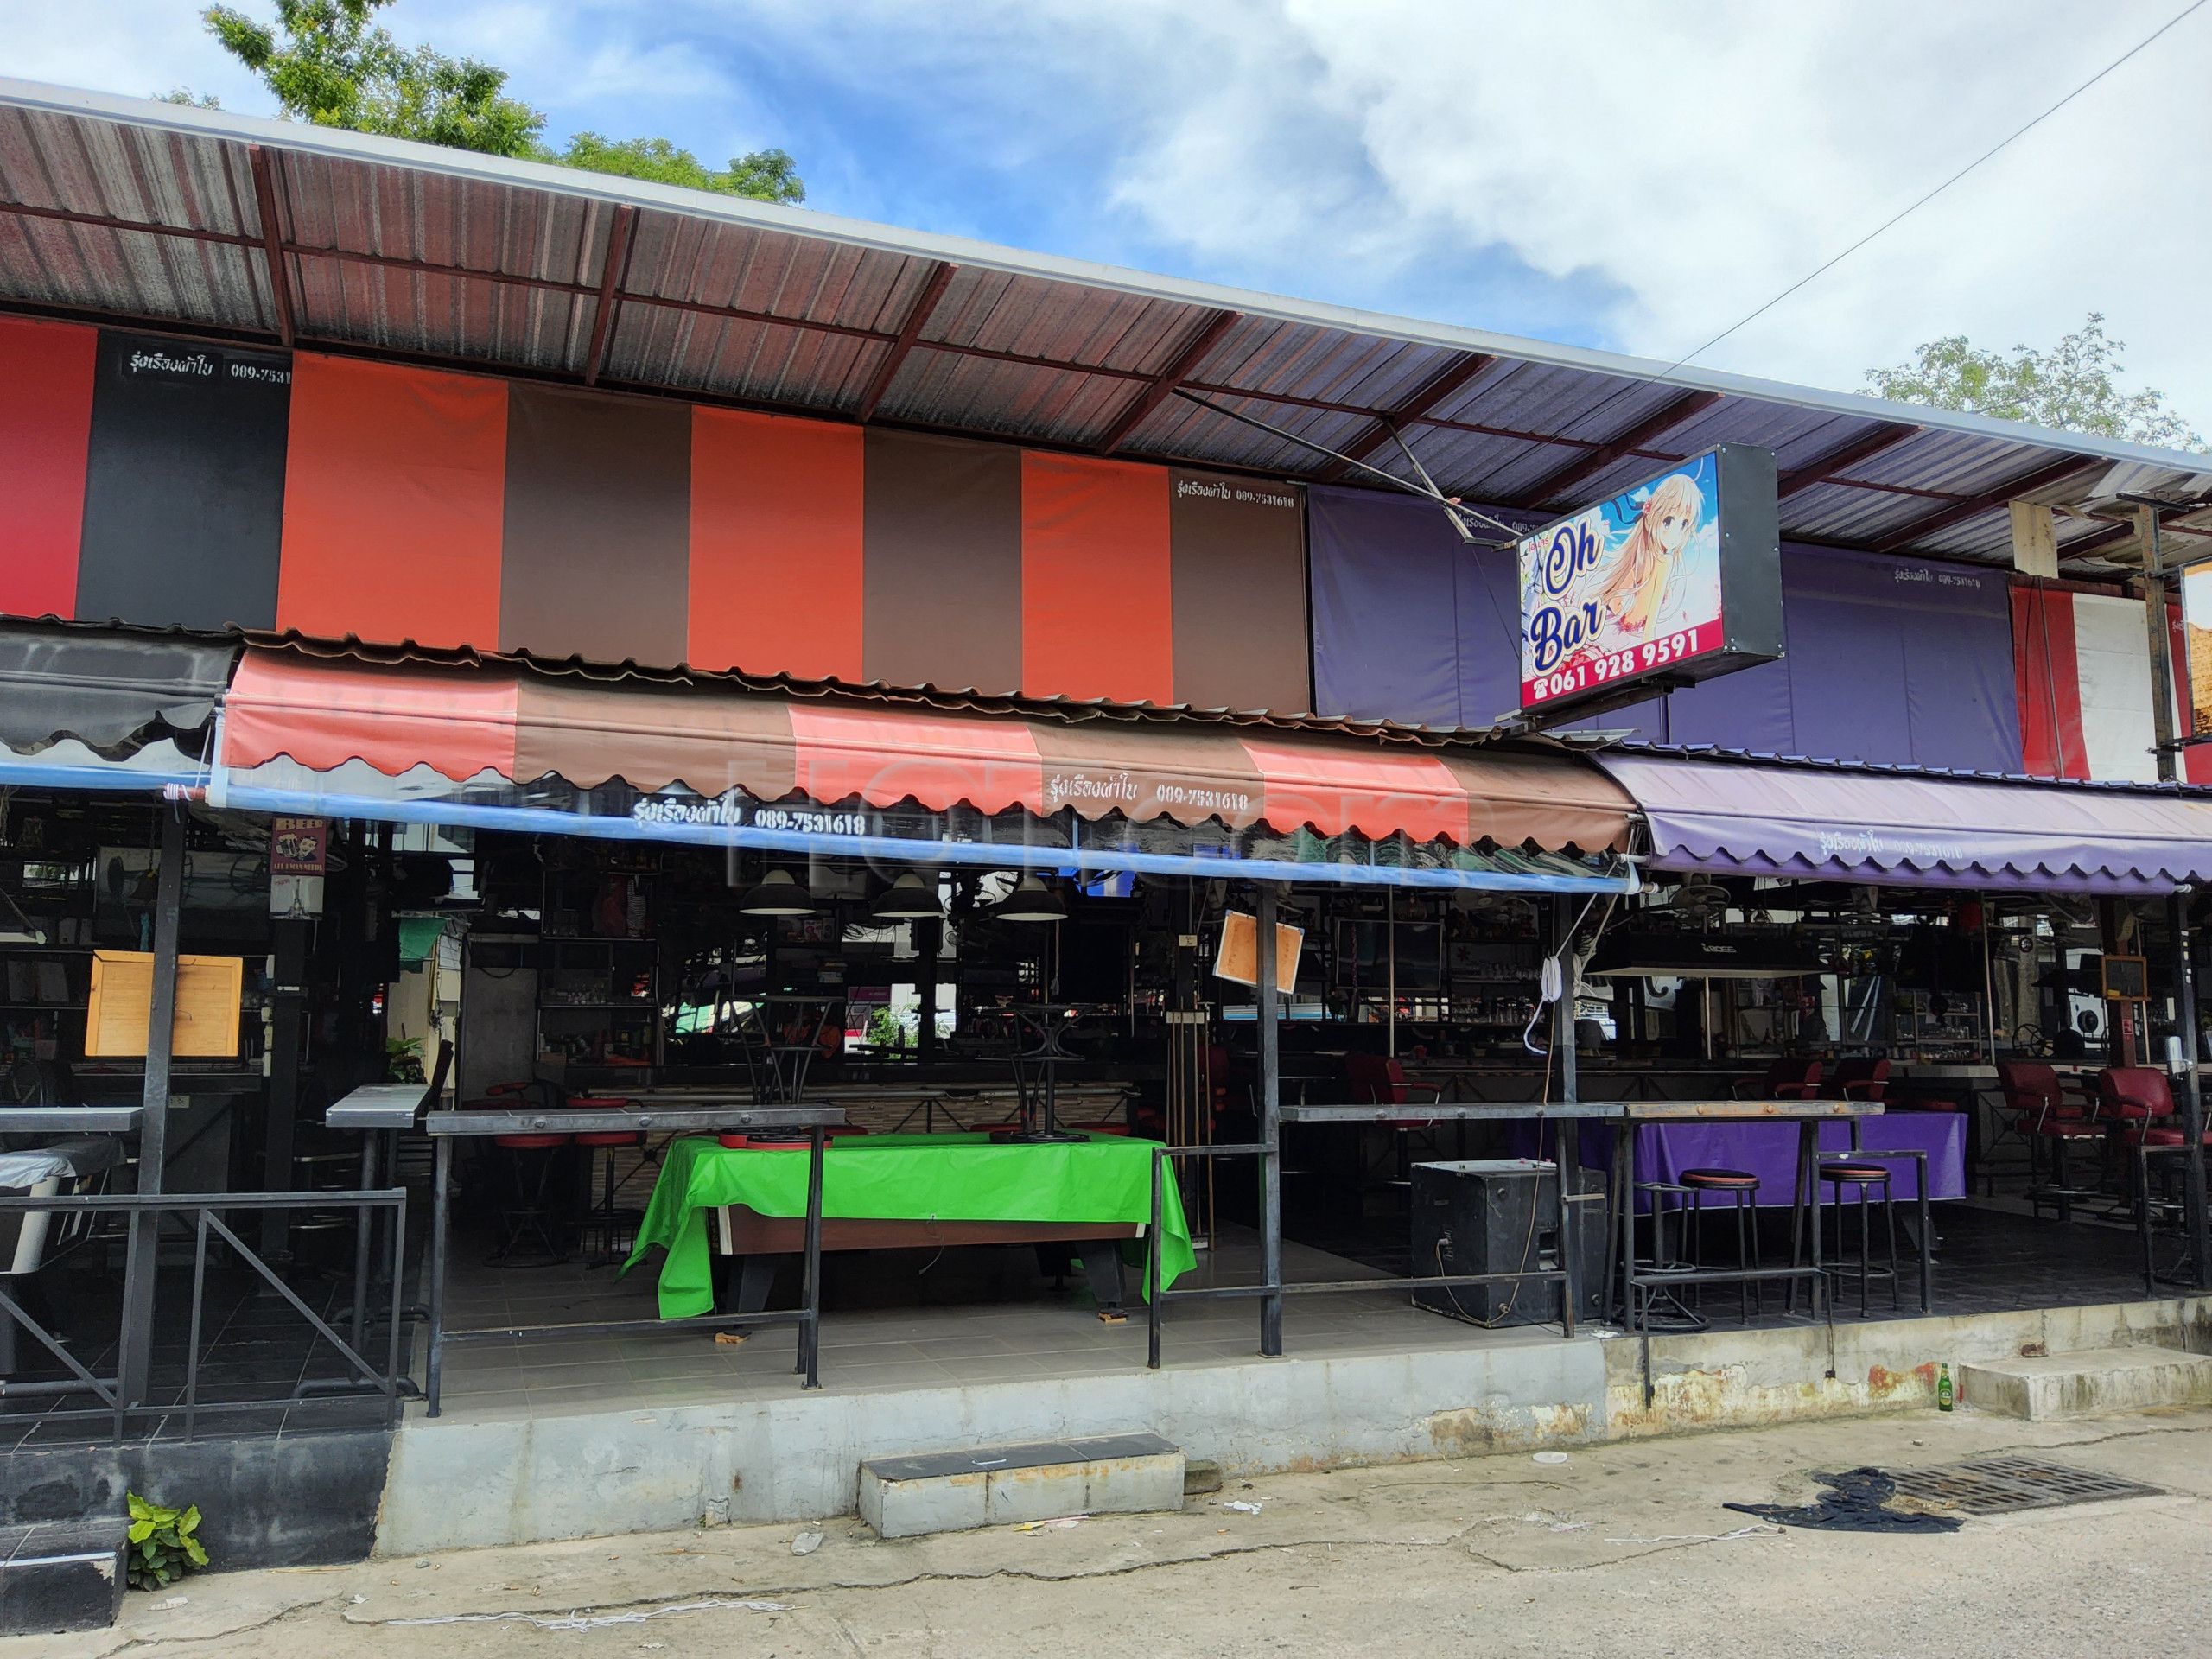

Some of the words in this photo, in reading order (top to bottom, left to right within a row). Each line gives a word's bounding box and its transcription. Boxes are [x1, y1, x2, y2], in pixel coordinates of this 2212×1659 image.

[1545, 519, 1603, 596] Oh
[1529, 601, 1603, 673] Bar
[1550, 667, 1586, 695] 061
[1594, 650, 1635, 681] 928
[1642, 628, 1698, 666] 9591
[754, 808, 866, 836] 089-7531618
[1155, 783, 1249, 811] 089-7531618
